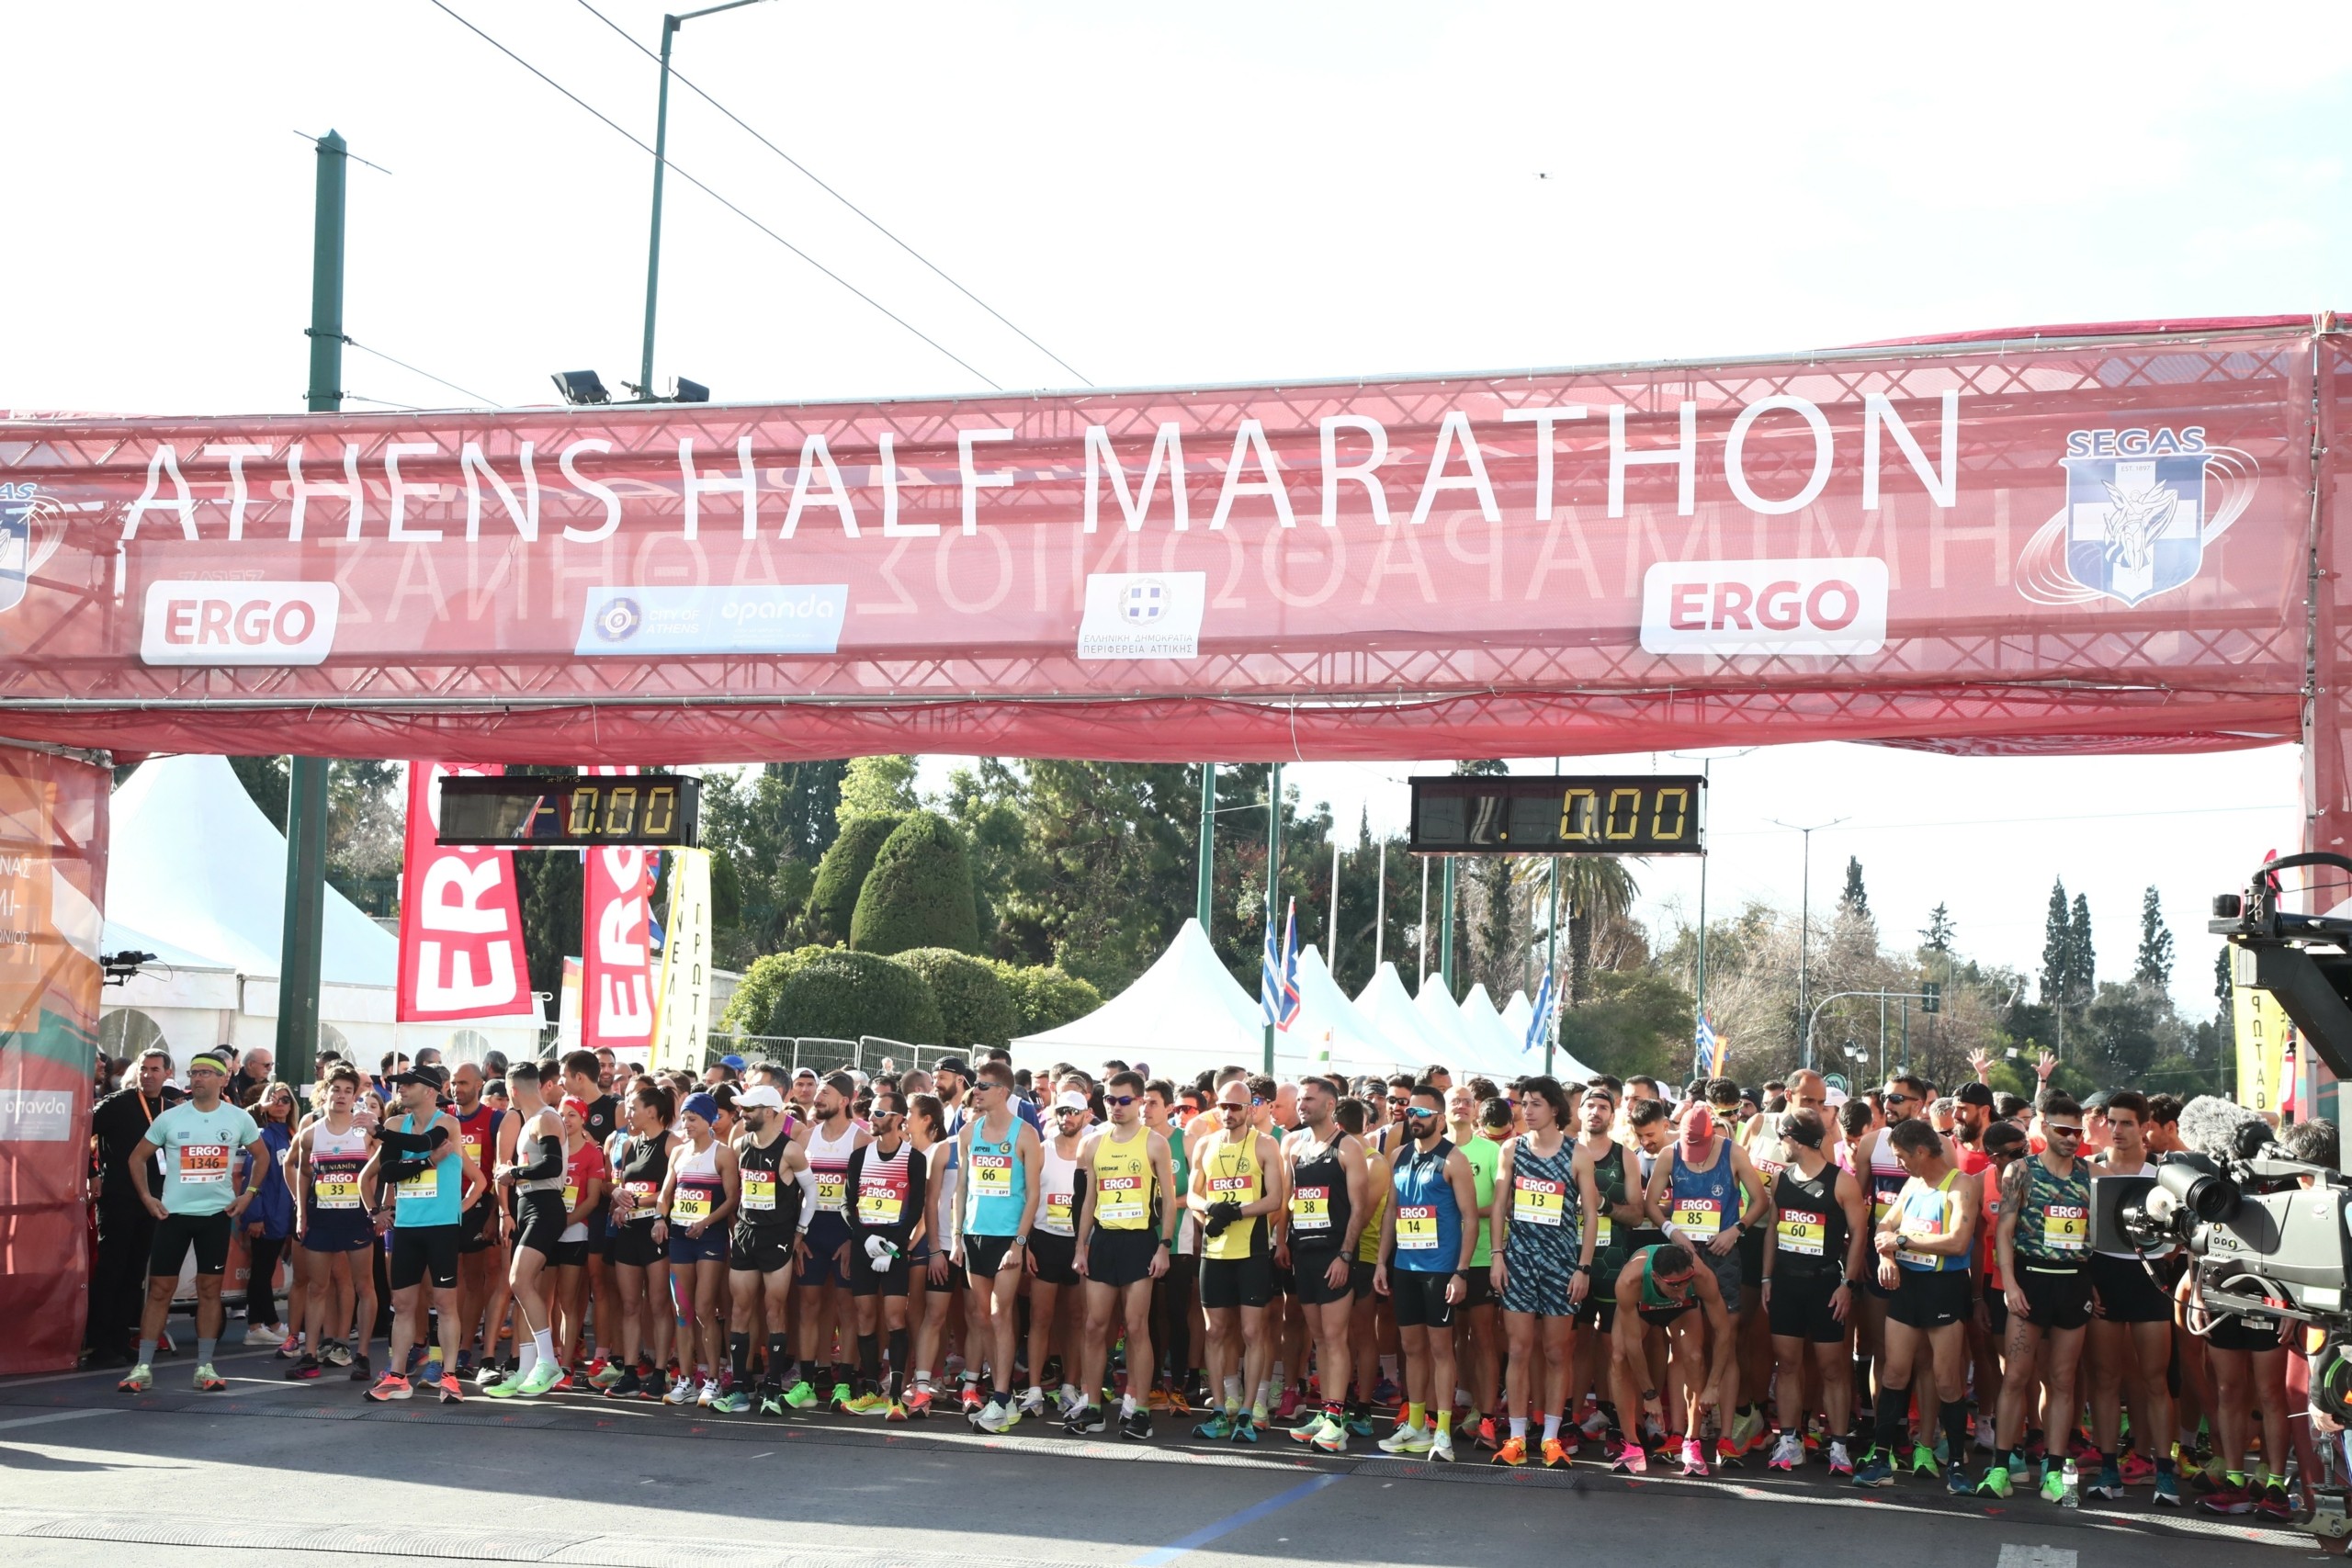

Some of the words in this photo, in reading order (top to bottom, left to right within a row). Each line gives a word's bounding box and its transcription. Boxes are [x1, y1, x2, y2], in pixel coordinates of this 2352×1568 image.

[2067, 426, 2205, 458] SEGAS
[123, 438, 622, 544] ATHENS
[678, 429, 1014, 540] HALF
[1083, 389, 1960, 534] MARATHON
[721, 593, 834, 626] opanda
[1668, 581, 1860, 632] ERGO
[649, 609, 678, 621] CITY
[681, 609, 700, 620] OF
[164, 599, 316, 646] ERGO
[646, 623, 699, 635] ATHENS
[1084, 635, 1130, 643] ΕΛΛΗΝΙΚΗ
[1083, 645, 1145, 654] ΠΕΡΙΦΕΡΕΙΑ
[1150, 645, 1193, 653] ΑΤΤΙΚΗΣ
[188, 1145, 220, 1156] ERGO
[189, 1157, 220, 1169] 1346
[976, 1156, 1005, 1167] ERGO
[323, 1173, 354, 1183] ERGO
[743, 1169, 768, 1182] ERGO
[814, 1173, 842, 1184] ERGO
[982, 1169, 996, 1180] 66
[330, 1184, 345, 1195] 33
[752, 1183, 758, 1194] 3
[1103, 1179, 1134, 1190] ERGO
[1213, 1178, 1244, 1190] ERGO
[1522, 1179, 1556, 1193] ERGO
[676, 1188, 705, 1200] ERGO
[820, 1185, 833, 1197] 25
[866, 1187, 896, 1199] ERGO
[1115, 1191, 1122, 1203] 2
[1222, 1190, 1237, 1202] 22
[1298, 1188, 1321, 1199] ERGO
[876, 1199, 883, 1210] 9
[1531, 1193, 1544, 1207] 13
[1681, 1200, 1713, 1211] ERGO
[680, 1201, 698, 1213] 206
[1304, 1201, 1315, 1213] 38
[1400, 1207, 1428, 1218] ERGO
[2050, 1205, 2082, 1218] ERGO
[1687, 1212, 1702, 1224] 85
[1784, 1211, 1817, 1224] ERGO
[1408, 1220, 1420, 1233] 14
[1791, 1224, 1806, 1237] 60
[2064, 1221, 2073, 1234] 6
